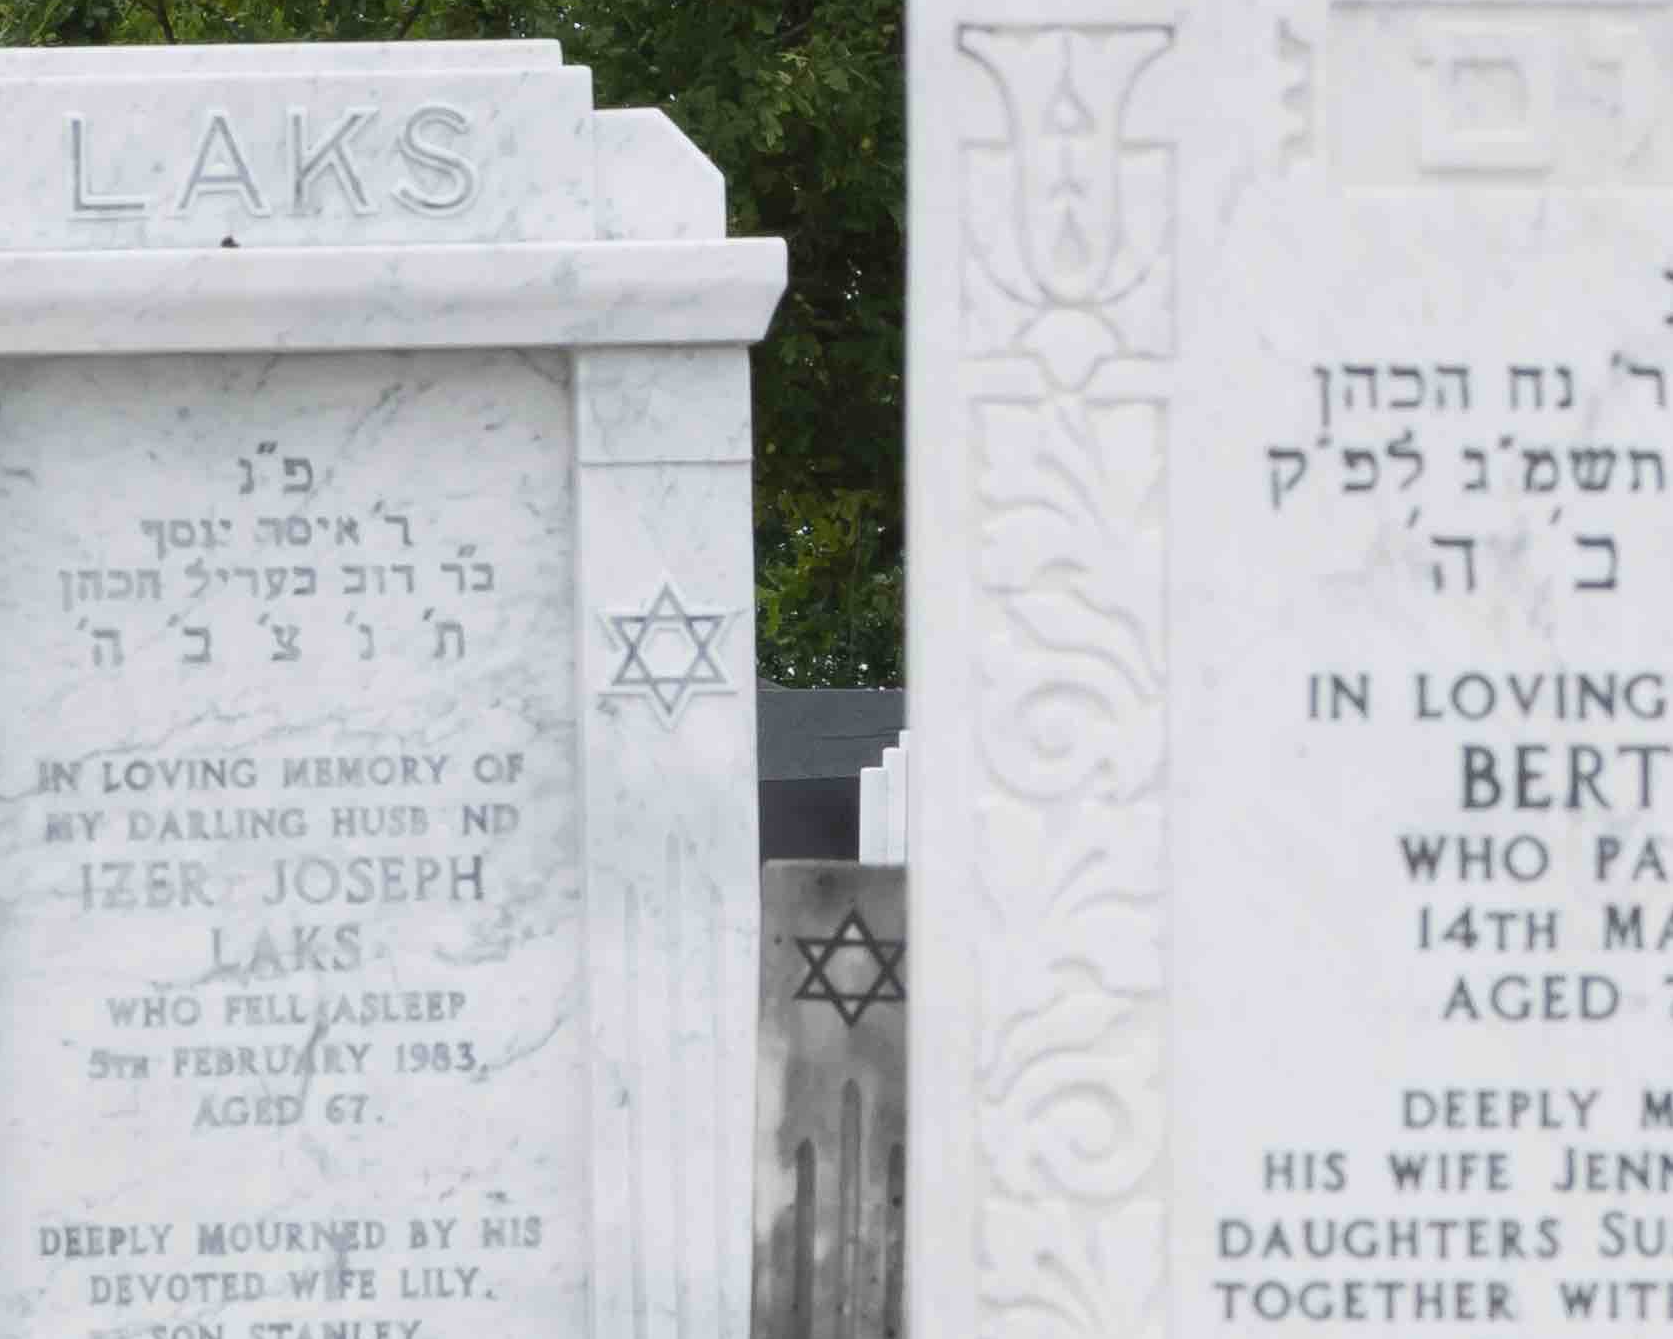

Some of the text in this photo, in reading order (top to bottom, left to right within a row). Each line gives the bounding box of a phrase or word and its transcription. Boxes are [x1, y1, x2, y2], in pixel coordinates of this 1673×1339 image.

[62, 105, 480, 220] LAKS
[1314, 364, 1471, 427] הכהן
[1510, 365, 1573, 410] נח
[58, 567, 162, 612] הכהן
[1309, 672, 1668, 721] IN LOVING
[38, 752, 525, 793] IN LOVING MEMORY OF
[45, 811, 104, 843] MY
[128, 807, 308, 842] DARLING
[1399, 835, 1550, 882] WHO
[81, 855, 485, 911] IZER JOSEPH
[210, 925, 363, 972] LAKS
[1418, 905, 1557, 951] 14TH
[106, 991, 467, 1028] WHO FELL ASLEEP
[1444, 974, 1620, 1021] AGED
[173, 1044, 374, 1078] FEBRUARY
[194, 1095, 303, 1128] AGED
[1403, 1090, 1599, 1130] DEEPLY
[1265, 1152, 1346, 1192] HIS
[1388, 1152, 1510, 1192] WIFE
[40, 1215, 543, 1257] DEEPLY MOURNED BY HIS
[1218, 1218, 1561, 1259] DAUGHTERS
[89, 1273, 263, 1306] DEVOTED
[289, 1269, 377, 1302] WIFE
[1215, 1281, 1673, 1321] TOGETHER WIT
